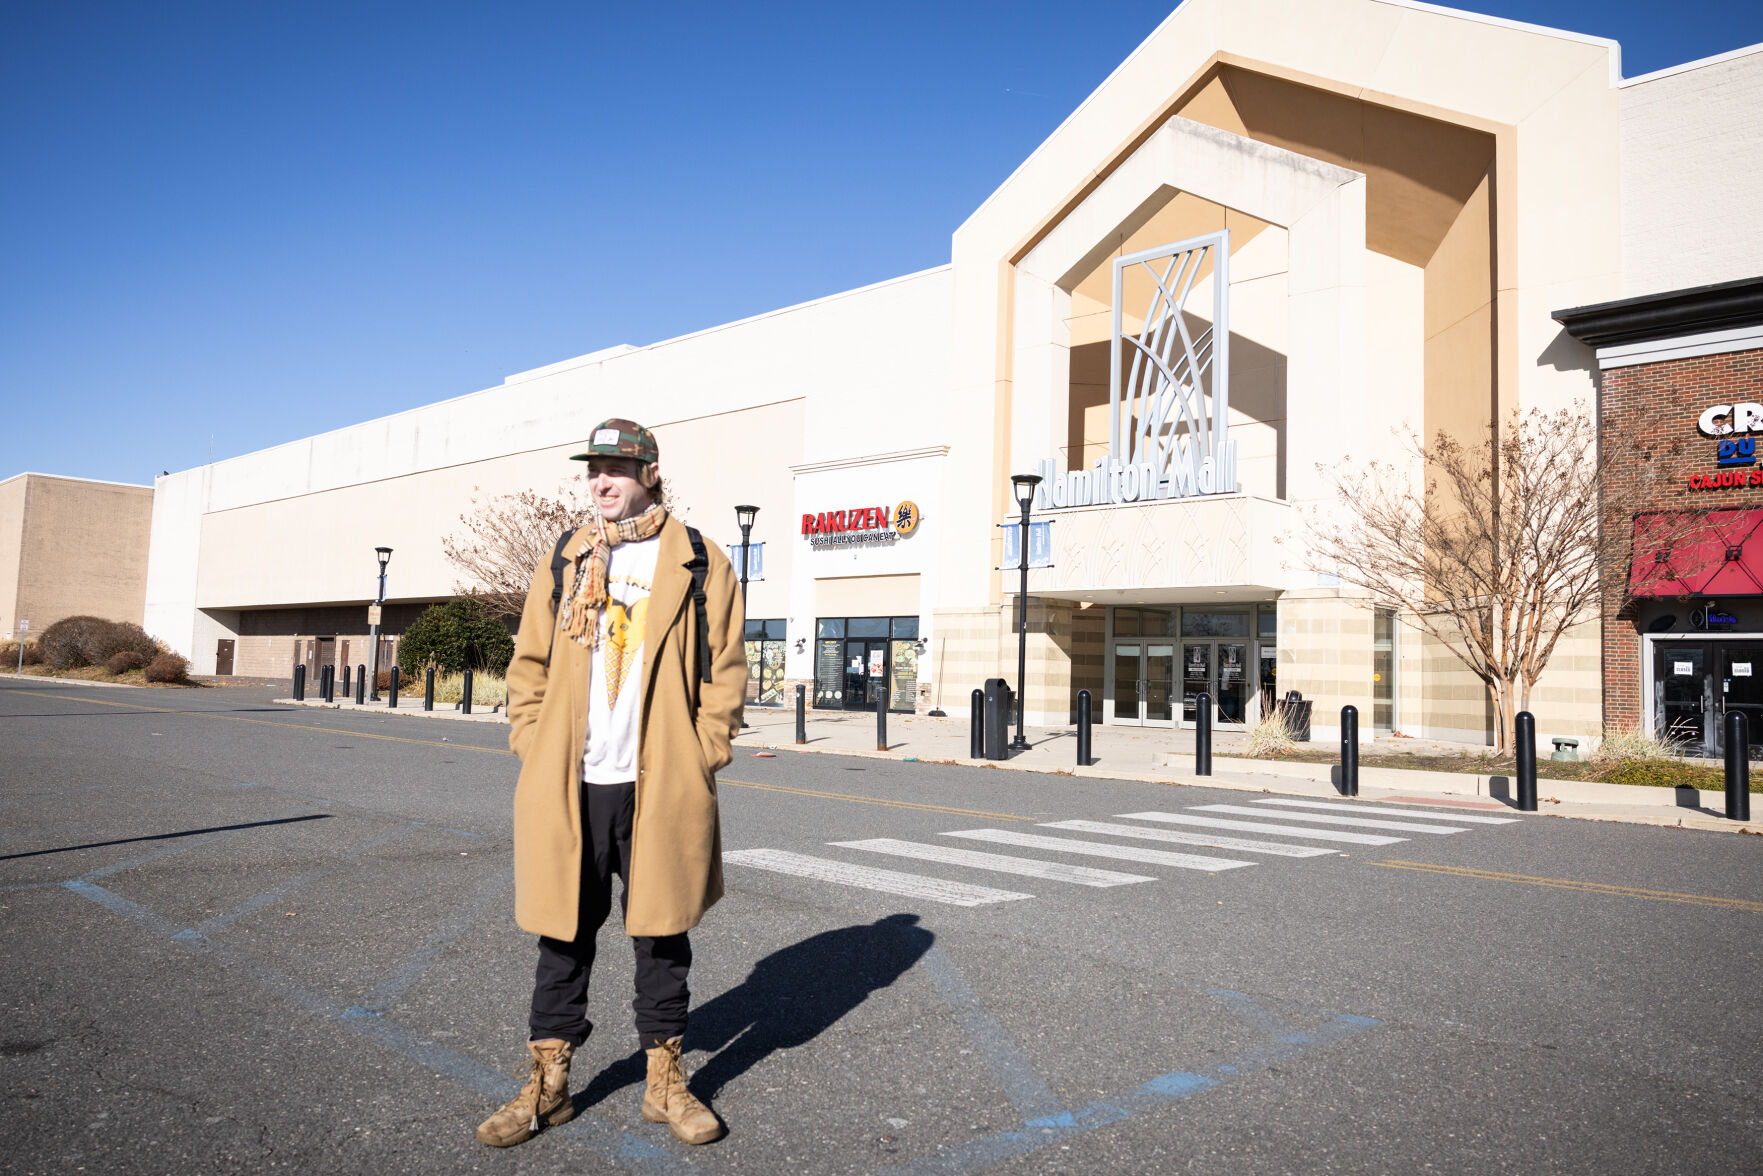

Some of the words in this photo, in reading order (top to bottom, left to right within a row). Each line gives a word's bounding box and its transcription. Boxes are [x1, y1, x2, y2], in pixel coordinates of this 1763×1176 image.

[1719, 437, 1755, 457] DU
[1036, 455, 1157, 509] Hamilton
[1167, 440, 1237, 499] Mall
[1690, 471, 1746, 489] CAJUN
[801, 506, 889, 535] RAKUZEN
[811, 536, 831, 546] SUSHI
[832, 535, 846, 545] ALL
[847, 534, 862, 544] YOU
[863, 533, 878, 543] CAN
[879, 532, 895, 541] EAT
